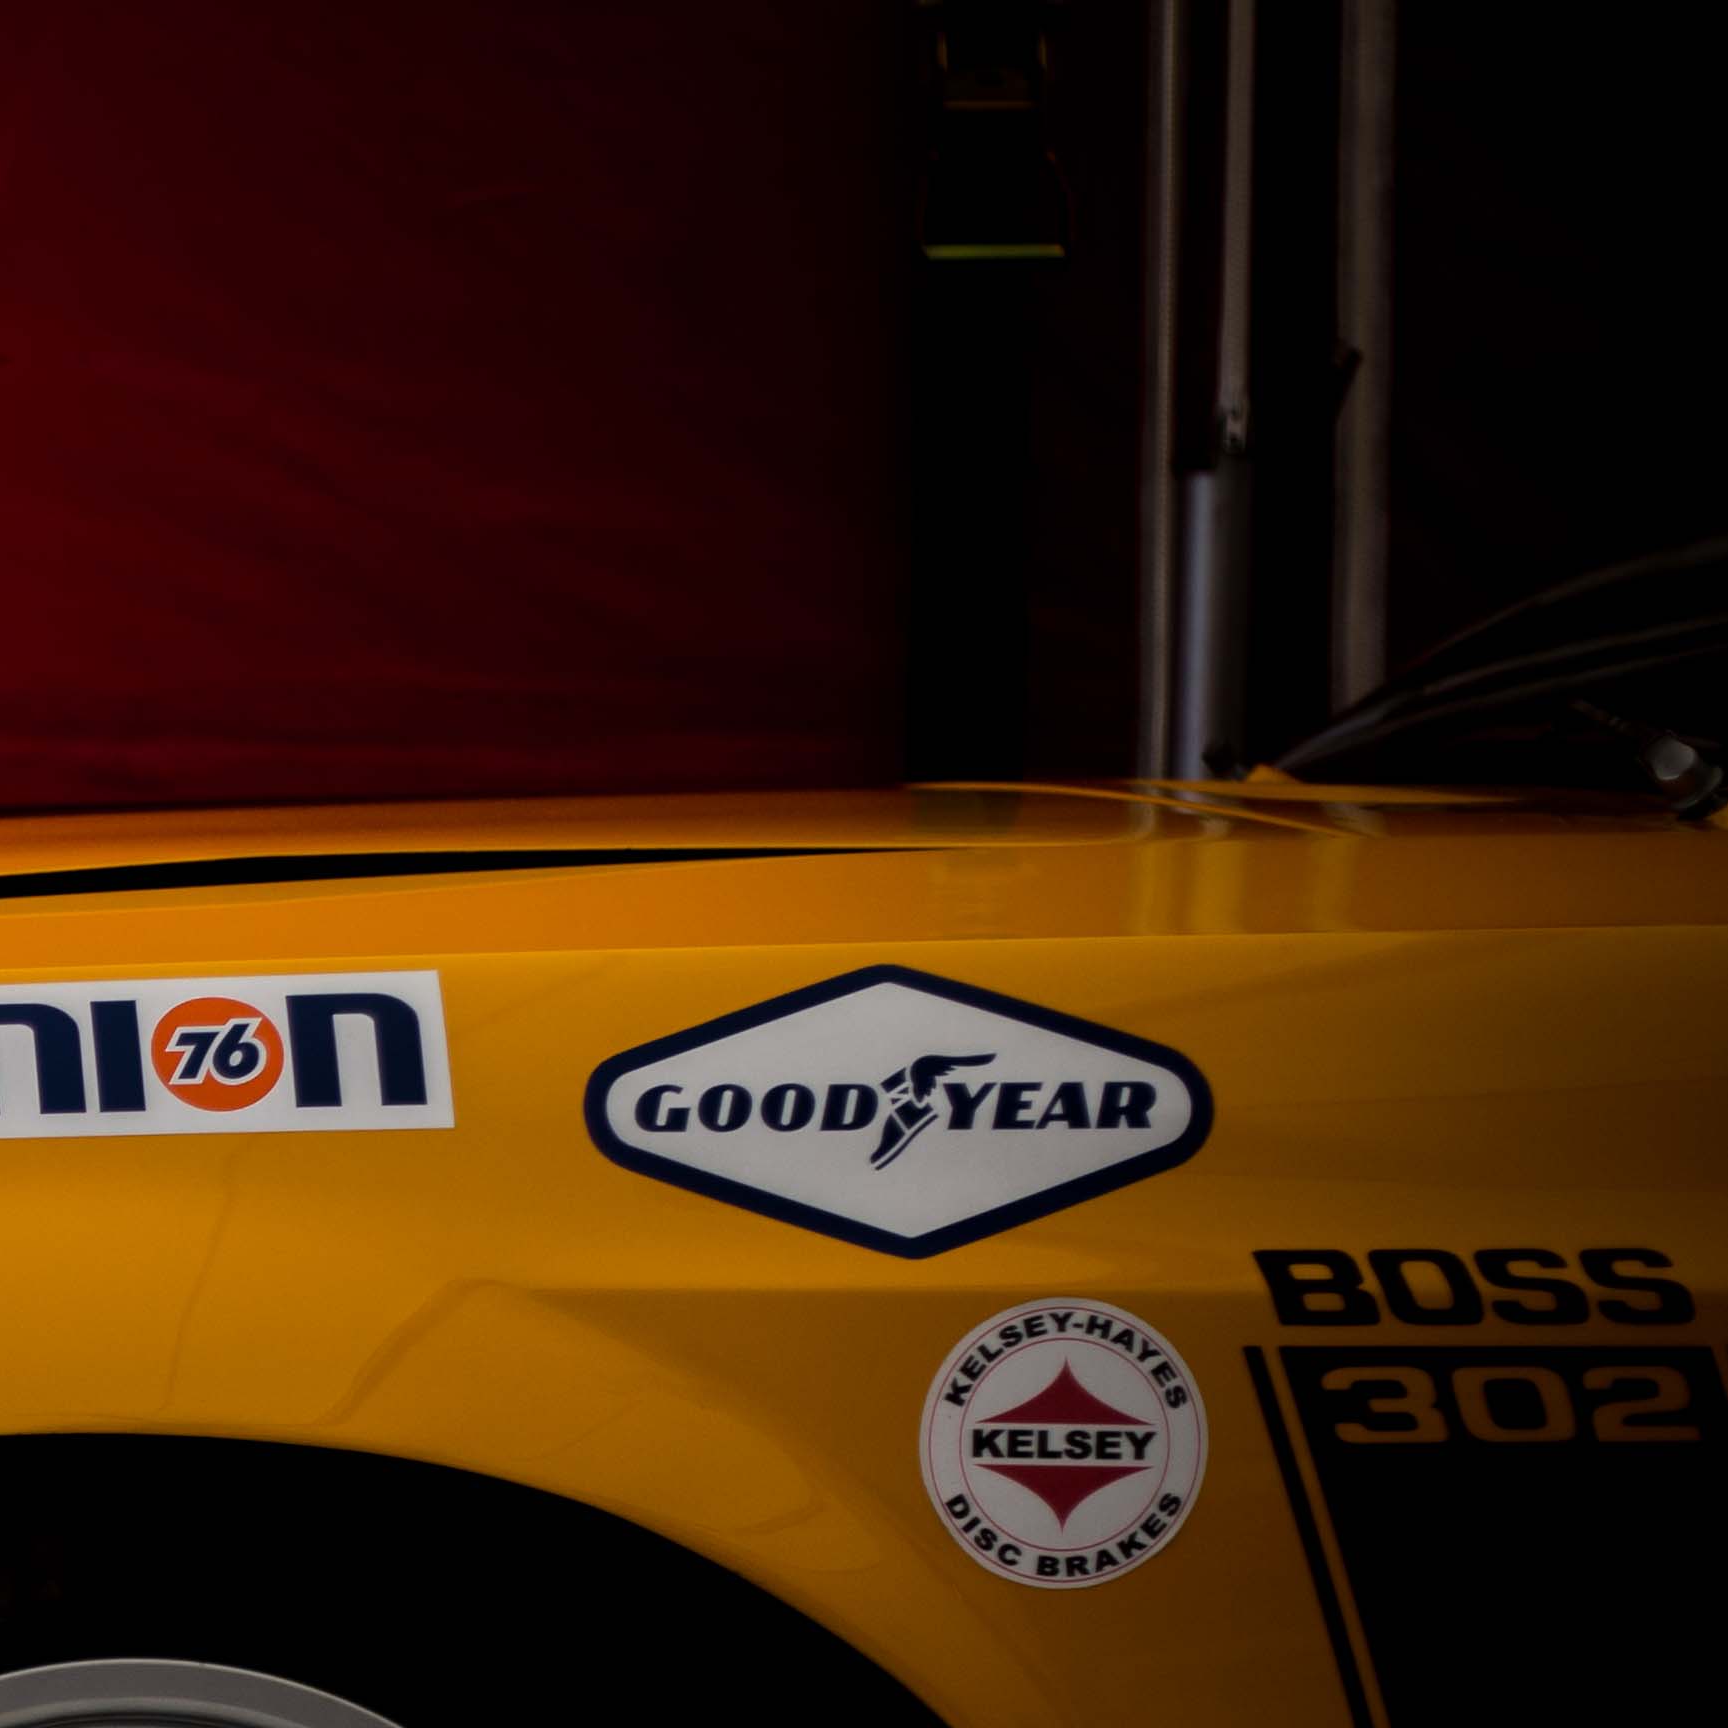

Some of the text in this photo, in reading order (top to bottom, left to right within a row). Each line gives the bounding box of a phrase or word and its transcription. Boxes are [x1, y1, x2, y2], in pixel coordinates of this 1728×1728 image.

[165, 1017, 268, 1086] 76
[1253, 1249, 1695, 1325] BOSS
[945, 1312, 1187, 1409] KELSEY-HAYES
[972, 1428, 1156, 1460] KELSEY
[1320, 1365, 1704, 1445] 302
[945, 1492, 1183, 1577] DISC BRAKES
